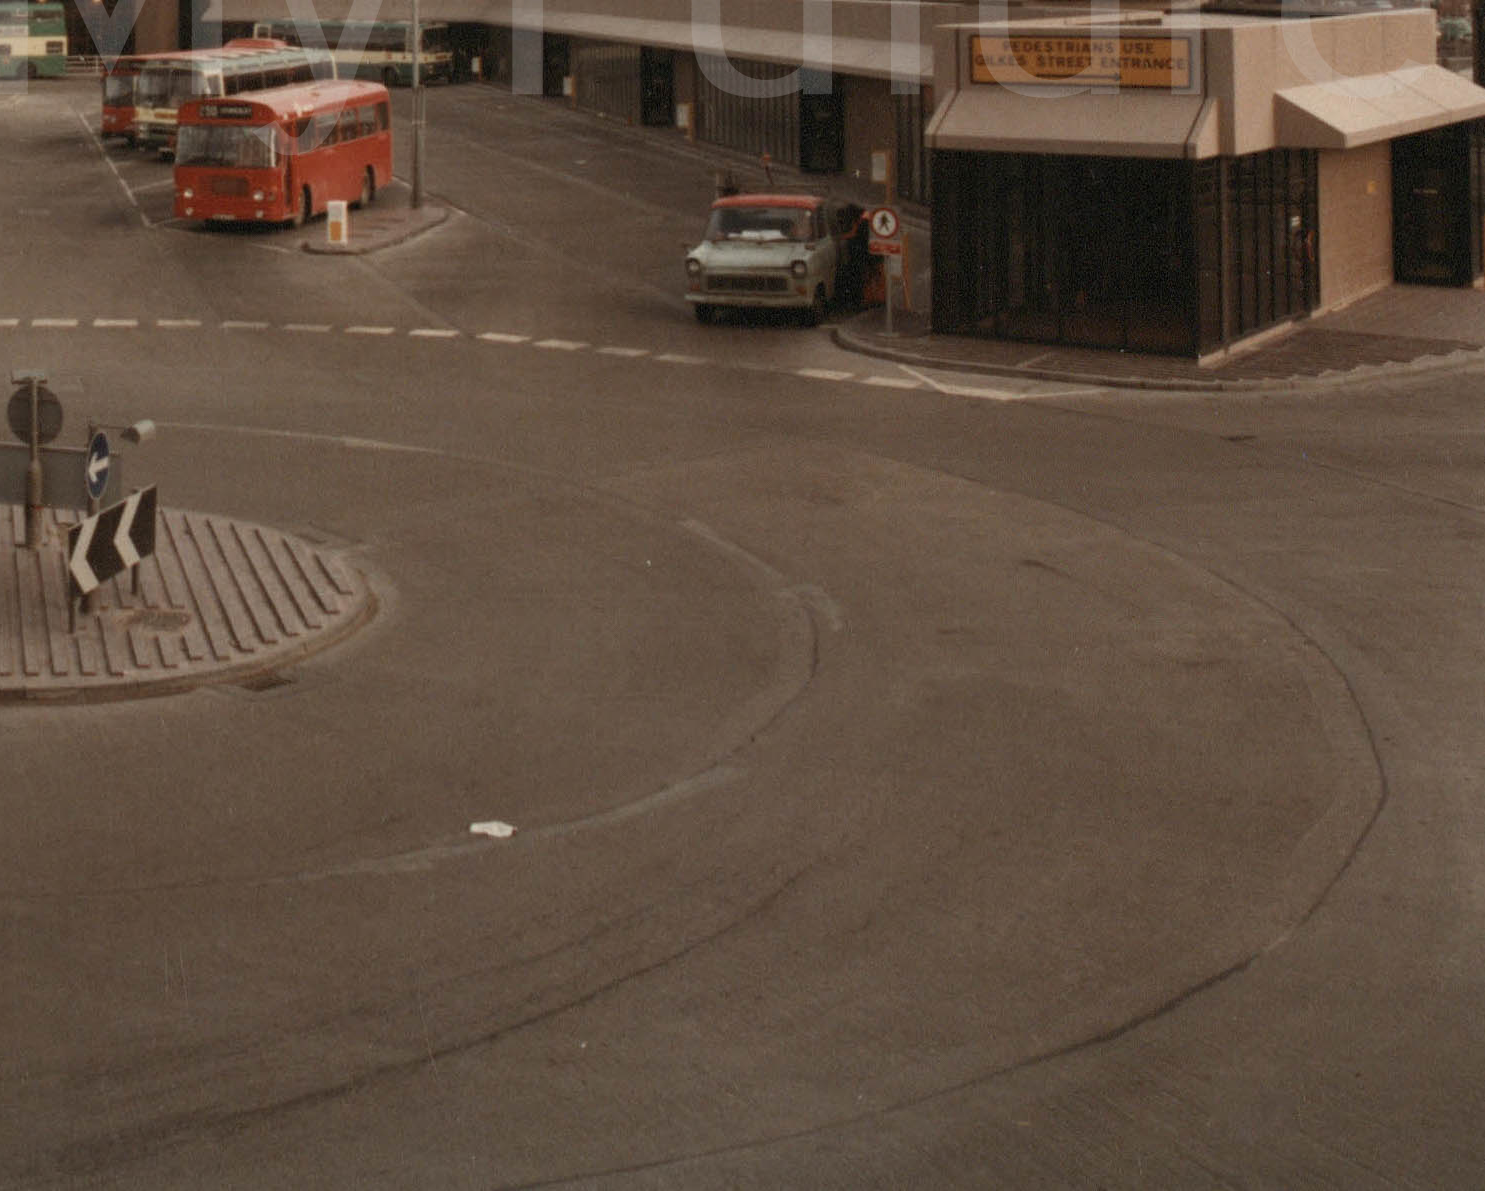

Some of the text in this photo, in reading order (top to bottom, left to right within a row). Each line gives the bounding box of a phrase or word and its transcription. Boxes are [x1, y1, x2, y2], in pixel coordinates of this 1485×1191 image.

[1002, 39, 1155, 55] PEDESTRIANS USE
[974, 54, 1188, 71] GILKES STREET ENTRANCE
